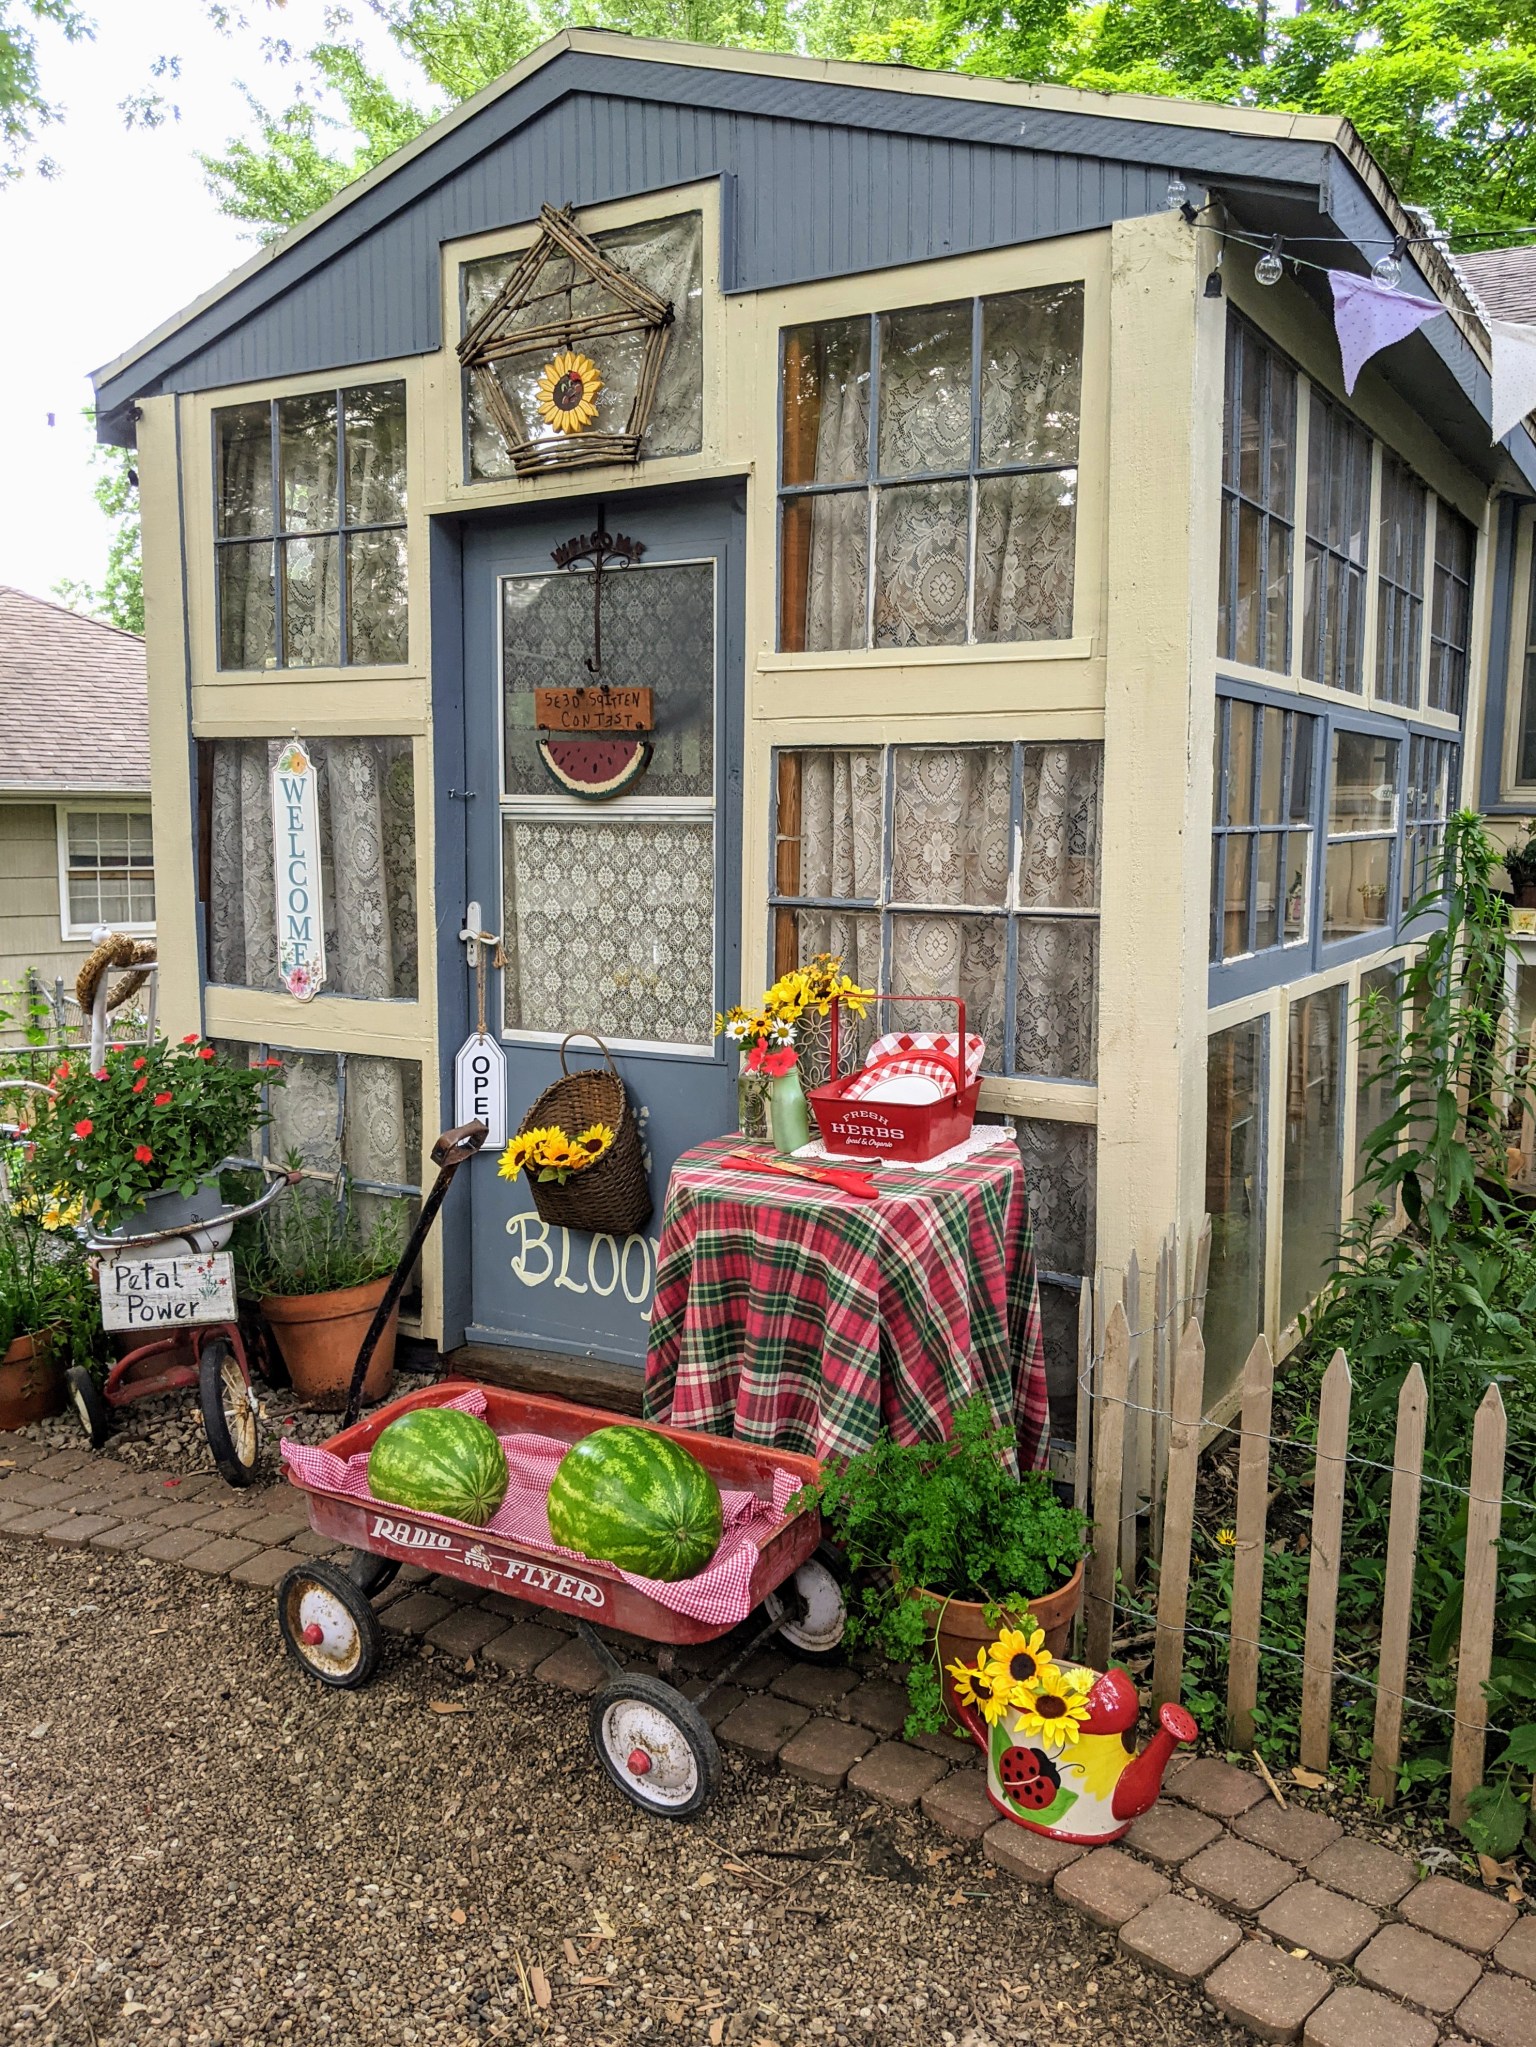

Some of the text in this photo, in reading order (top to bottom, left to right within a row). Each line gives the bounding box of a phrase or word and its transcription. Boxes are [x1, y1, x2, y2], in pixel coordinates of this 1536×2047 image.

[550, 531, 645, 565] WELCOME
[279, 777, 313, 967] WELCOME
[831, 1122, 905, 1140] HERBS
[842, 1110, 889, 1126] FRESH
[868, 1138, 893, 1149] Organic
[115, 1261, 184, 1293] Petal
[506, 1211, 660, 1321] BLOO
[128, 1294, 199, 1324] Power
[370, 1516, 453, 1549] RADIO
[502, 1559, 605, 1608] FLYER
